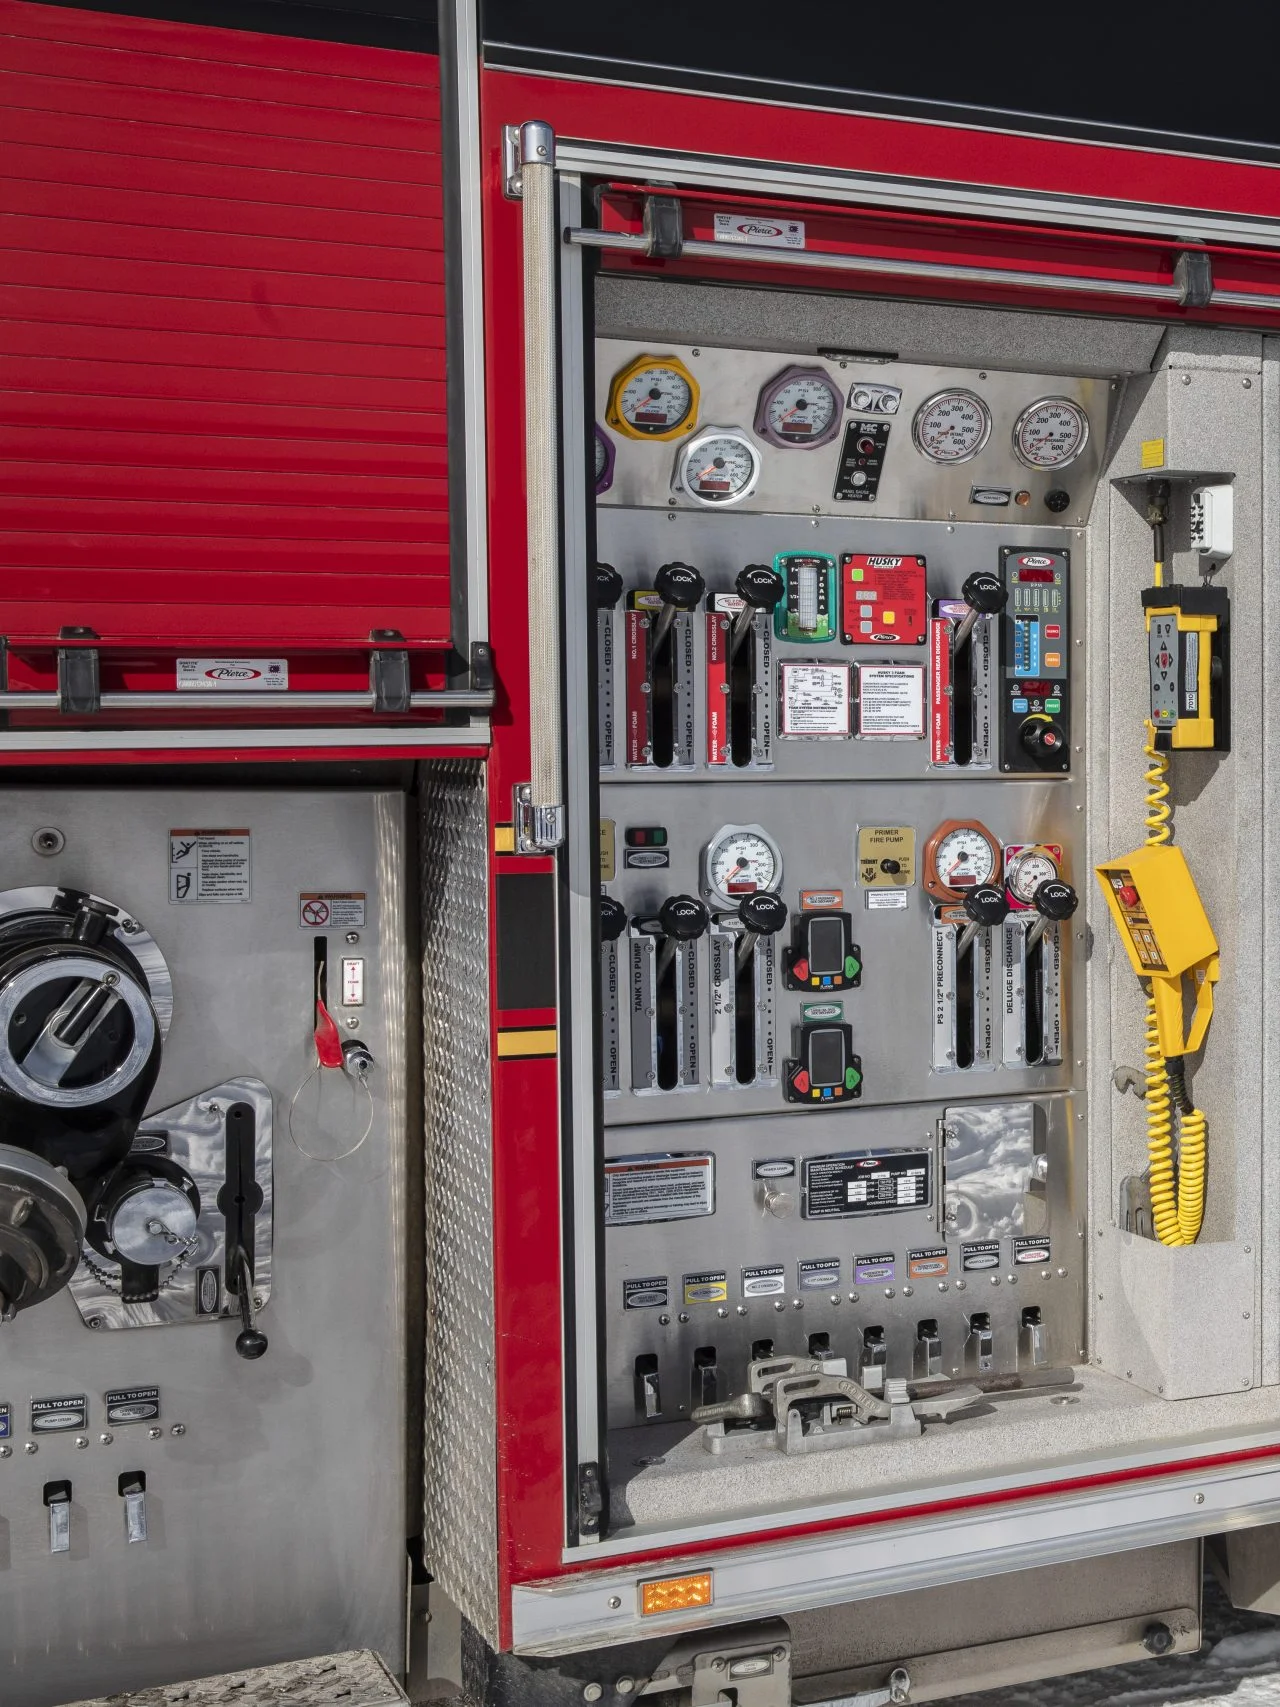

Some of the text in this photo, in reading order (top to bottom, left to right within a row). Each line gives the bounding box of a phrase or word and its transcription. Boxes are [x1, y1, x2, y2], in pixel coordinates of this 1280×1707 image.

[747, 225, 772, 234] Pierce
[938, 409, 950, 417] 200
[960, 413, 974, 421] 400
[929, 421, 942, 429] 100
[953, 438, 966, 446] 600
[868, 557, 901, 566] HUSKY
[1026, 557, 1048, 566] Pierce
[672, 575, 693, 583] LOCK
[753, 577, 773, 585] LOCK
[604, 627, 612, 666] CLOSED
[218, 667, 248, 678] Pierce
[685, 721, 693, 748] OPEN
[676, 908, 696, 916] LOCK
[755, 903, 775, 911] LOCK
[713, 940, 721, 987] CROSSLAY
[608, 954, 616, 993] CLOSED
[634, 942, 642, 1012] TANK TO PUMP
[714, 989, 722, 1006] 1/2"
[937, 1013, 944, 1025] PS
[609, 1047, 617, 1074] OPEN
[108, 1393, 126, 1401] PULL
[137, 1390, 157, 1398] OPEN
[32, 1402, 52, 1410] PULL
[63, 1399, 83, 1407] OPEN
